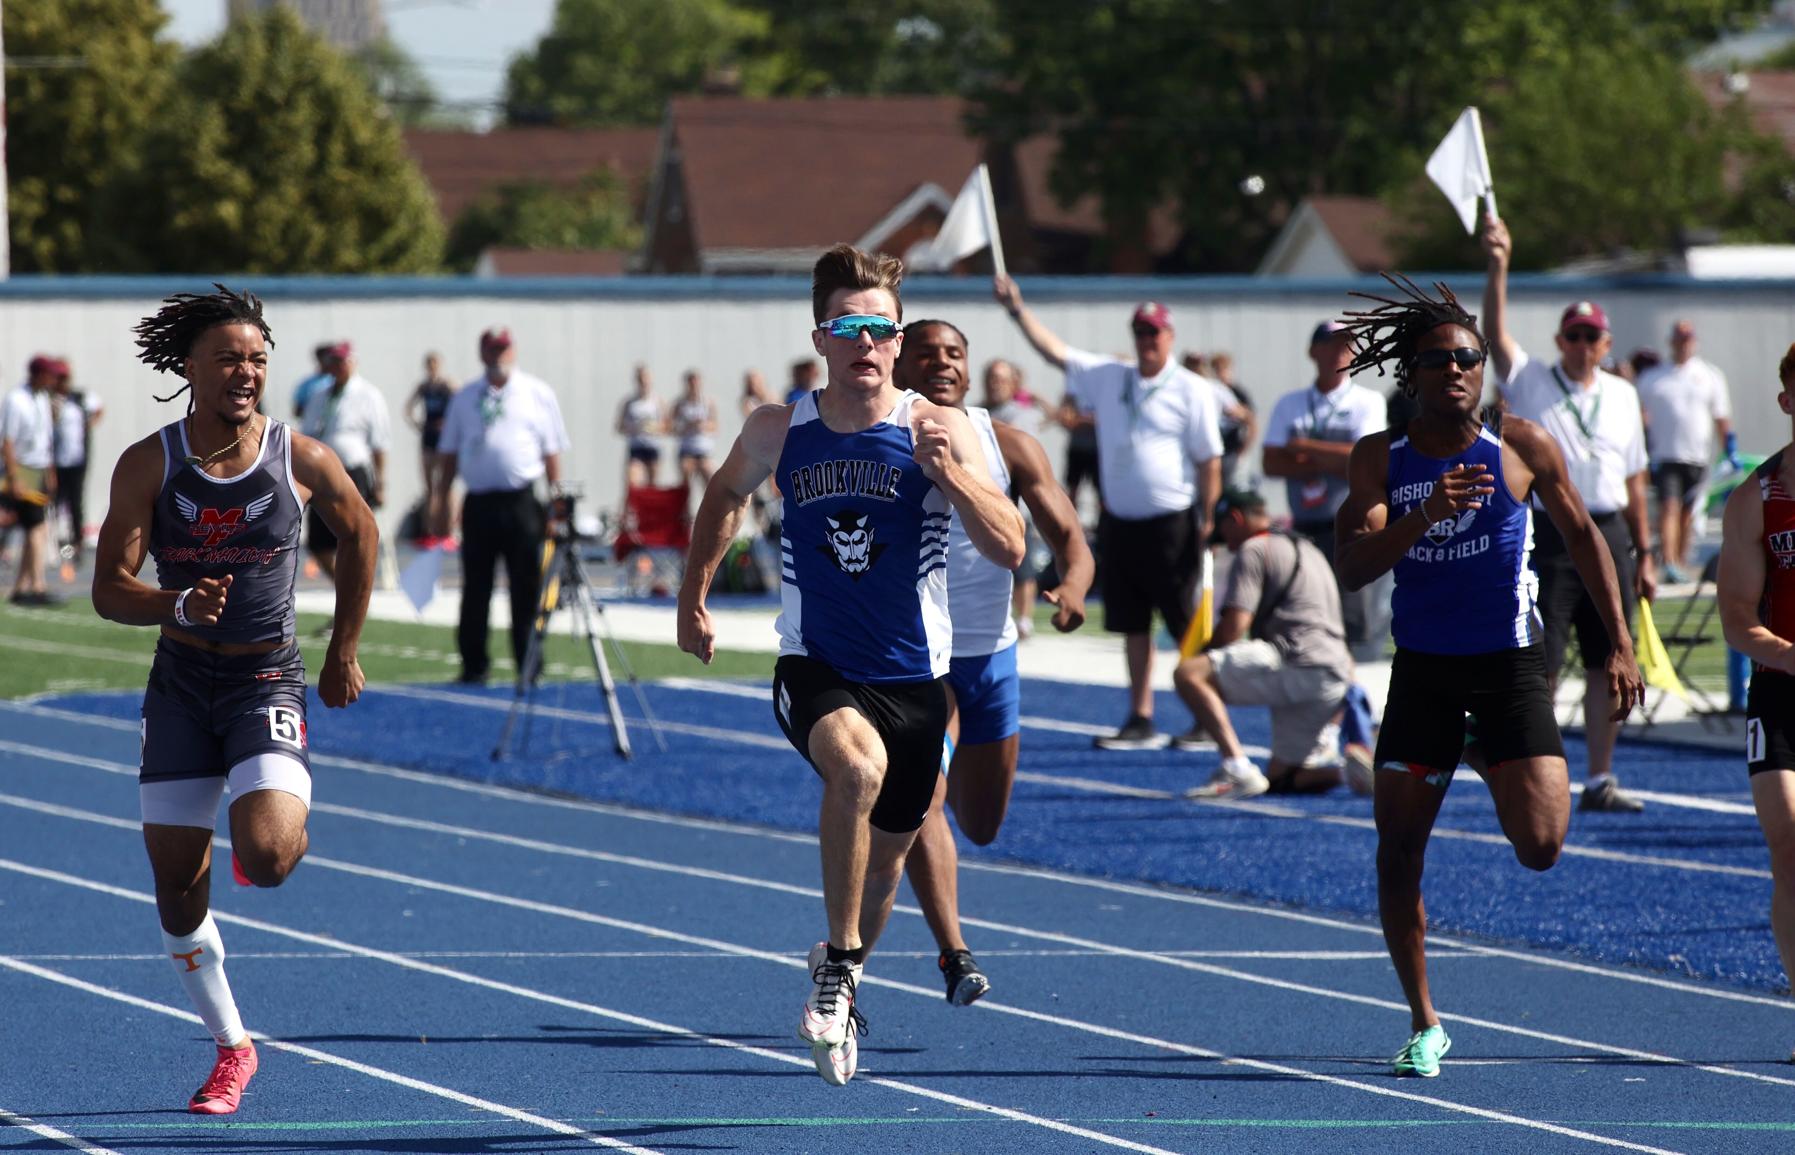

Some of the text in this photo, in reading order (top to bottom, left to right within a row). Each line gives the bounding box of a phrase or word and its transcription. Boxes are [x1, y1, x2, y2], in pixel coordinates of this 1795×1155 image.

[791, 459, 902, 508] BROOKVILLE
[1391, 480, 1437, 506] BISHO
[1404, 544, 1434, 563] ACK
[1448, 534, 1489, 561] FIELD
[276, 709, 297, 742] 5
[1750, 720, 1758, 759] 1
